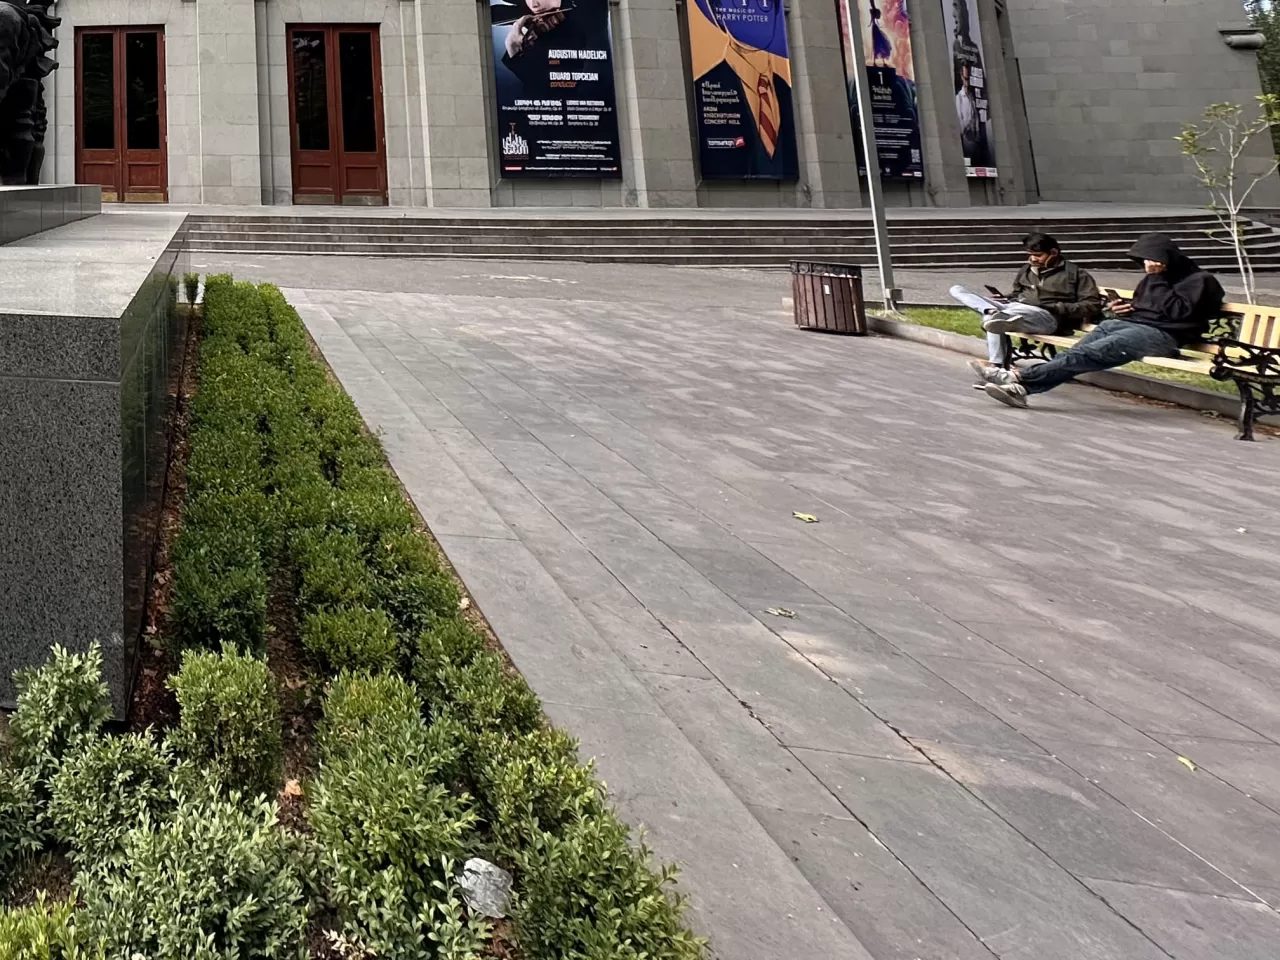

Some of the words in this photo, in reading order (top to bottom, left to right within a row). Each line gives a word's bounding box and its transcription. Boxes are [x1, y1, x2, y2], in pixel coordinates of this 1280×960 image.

[716, 13, 741, 21] HARRY
[743, 14, 769, 22] POTTER
[548, 49, 577, 59] AUGUSTIN
[578, 50, 607, 60] HADELICH
[549, 72, 571, 80] EDUARD
[878, 71, 883, 85] 1
